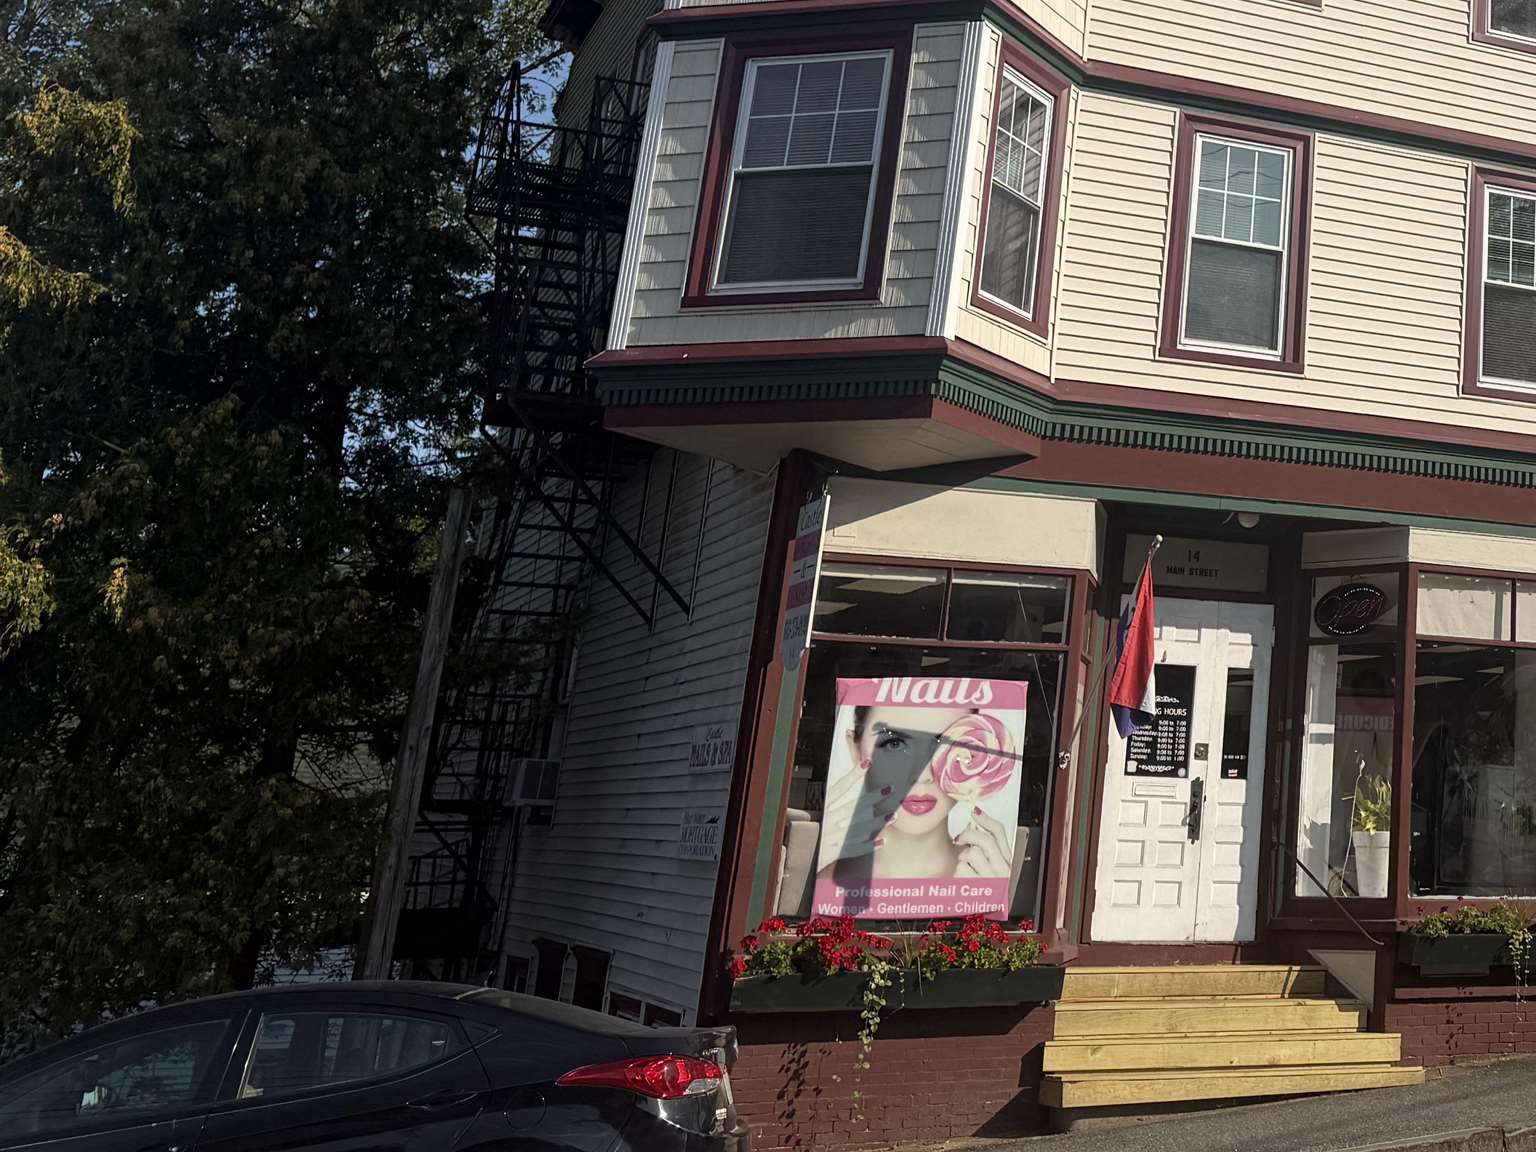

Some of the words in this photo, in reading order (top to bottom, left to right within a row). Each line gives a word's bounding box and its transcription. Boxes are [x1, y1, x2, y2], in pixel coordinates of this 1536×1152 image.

[1188, 549, 1201, 562] 14
[1166, 565, 1185, 576] MAIN
[1189, 567, 1220, 578] STREET
[873, 677, 993, 705] Nails
[1164, 708, 1187, 717] HOURS
[835, 886, 924, 898] Professional
[928, 885, 956, 897] Nail
[960, 885, 992, 897] Care
[818, 903, 865, 915] Women
[877, 902, 944, 915] Gentlemen
[955, 901, 1005, 914] Children
